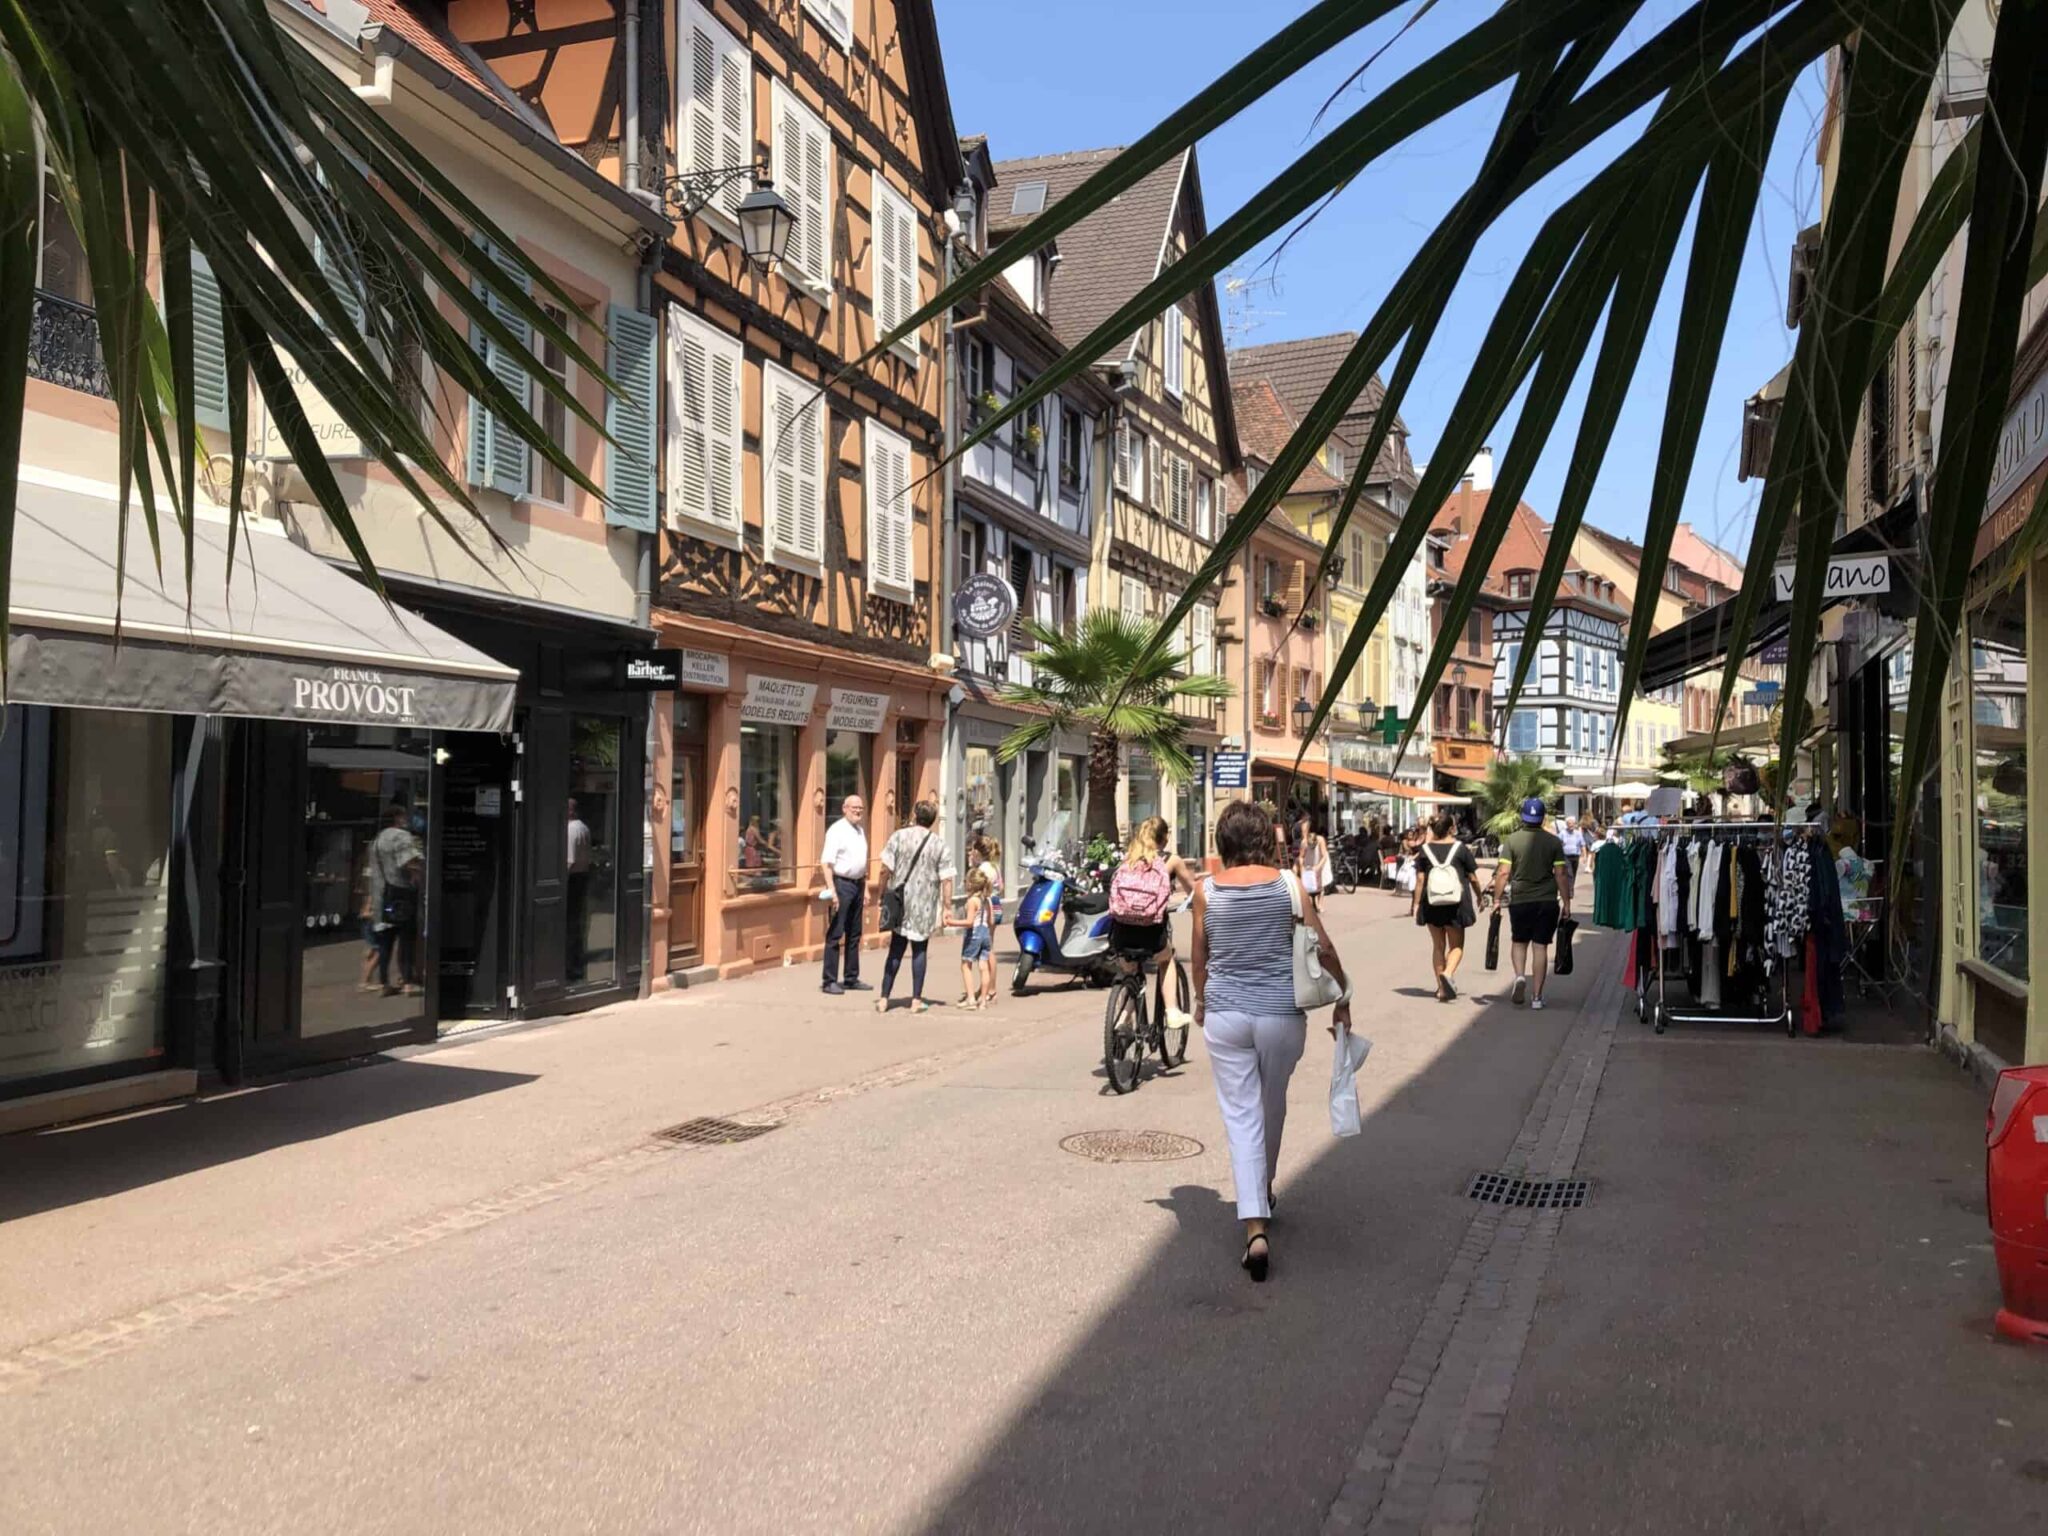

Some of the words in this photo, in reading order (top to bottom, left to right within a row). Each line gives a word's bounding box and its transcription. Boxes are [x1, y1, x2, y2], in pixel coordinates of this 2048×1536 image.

[267, 423, 356, 442] CFURE
[1780, 564, 1886, 593] vano
[333, 667, 382, 683] FRANCK
[627, 661, 665, 676] Barber
[758, 680, 806, 696] MAQUETTES
[294, 677, 415, 716] PROVOST
[840, 693, 880, 707] FIGURINES
[777, 710, 810, 722] REDUITS
[832, 715, 876, 729] MODELISME
